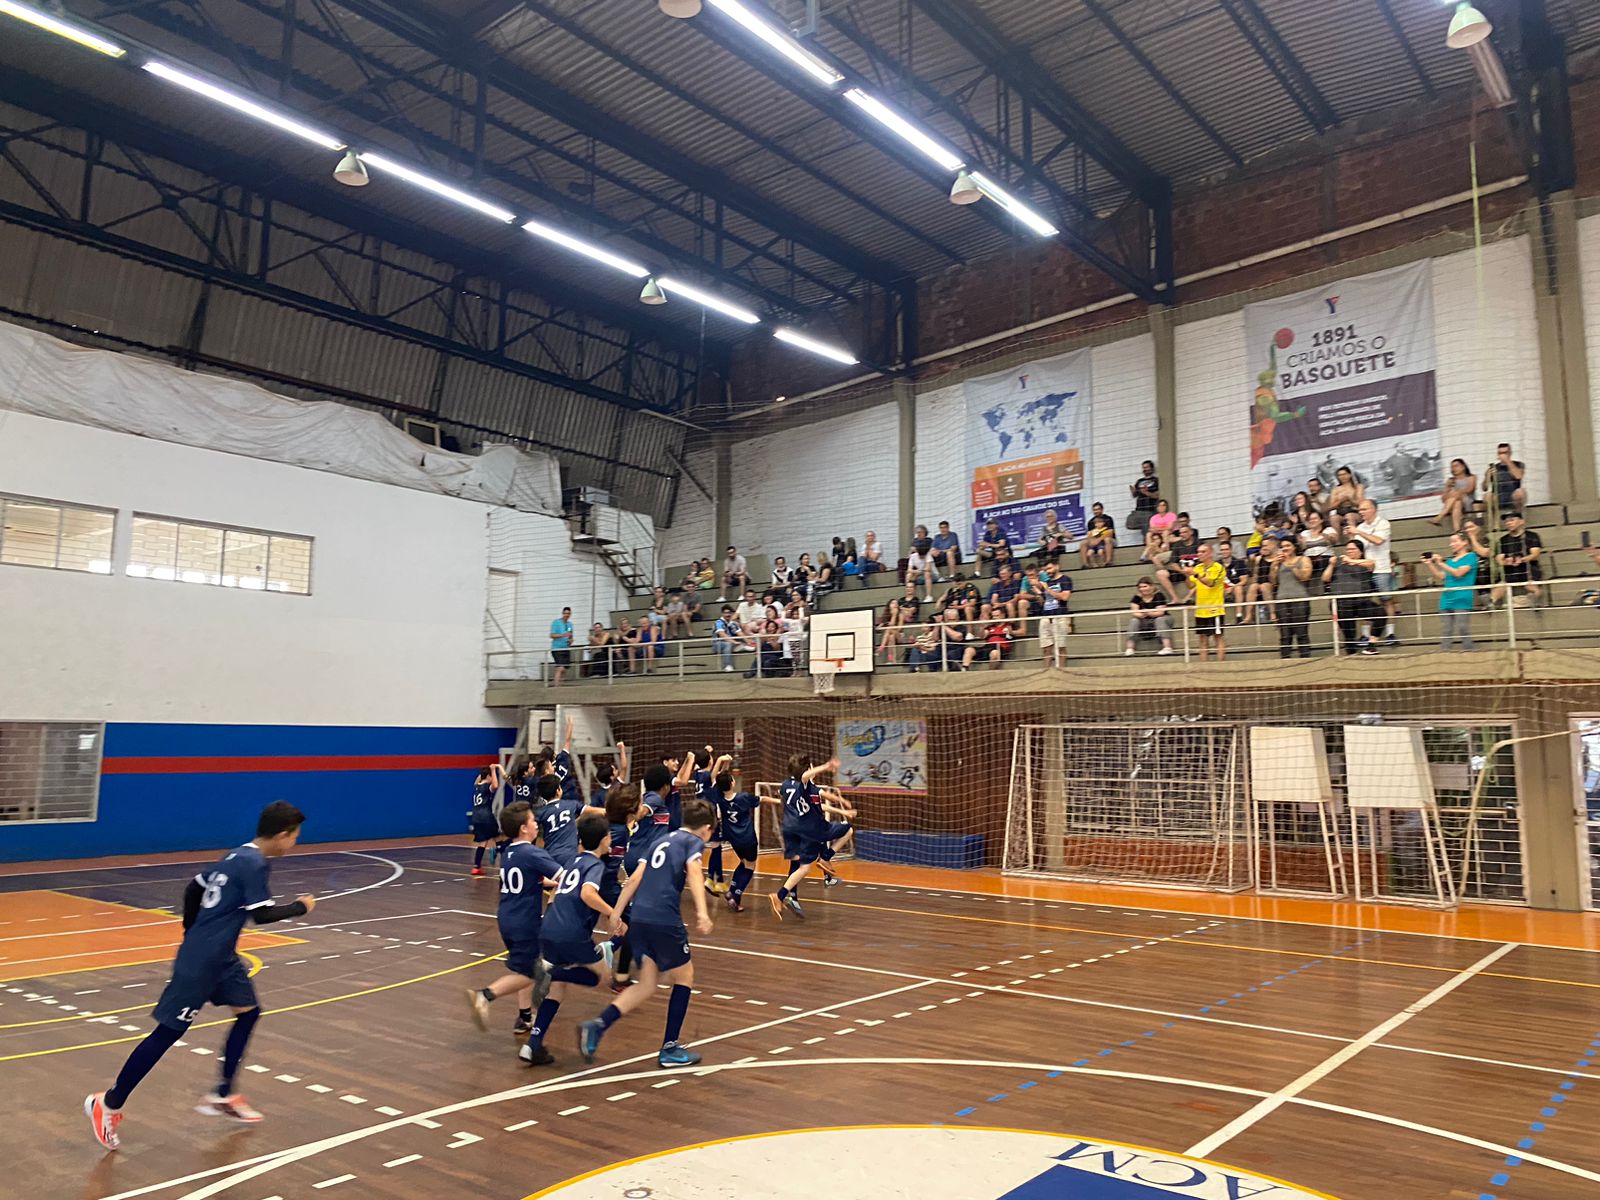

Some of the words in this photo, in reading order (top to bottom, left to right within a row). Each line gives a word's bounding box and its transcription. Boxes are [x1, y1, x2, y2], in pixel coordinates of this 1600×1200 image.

[1311, 324, 1358, 347] 1891
[1286, 342, 1367, 369] CRIAMOS
[1371, 335, 1387, 350] O
[1281, 351, 1396, 389] BASQUETE
[516, 785, 530, 797] 28
[785, 788, 796, 804] 7
[727, 810, 738, 823] 3
[650, 841, 670, 869] 6
[499, 866, 523, 894] 10
[555, 868, 581, 894] 19
[1046, 1141, 1292, 1200] ACM
